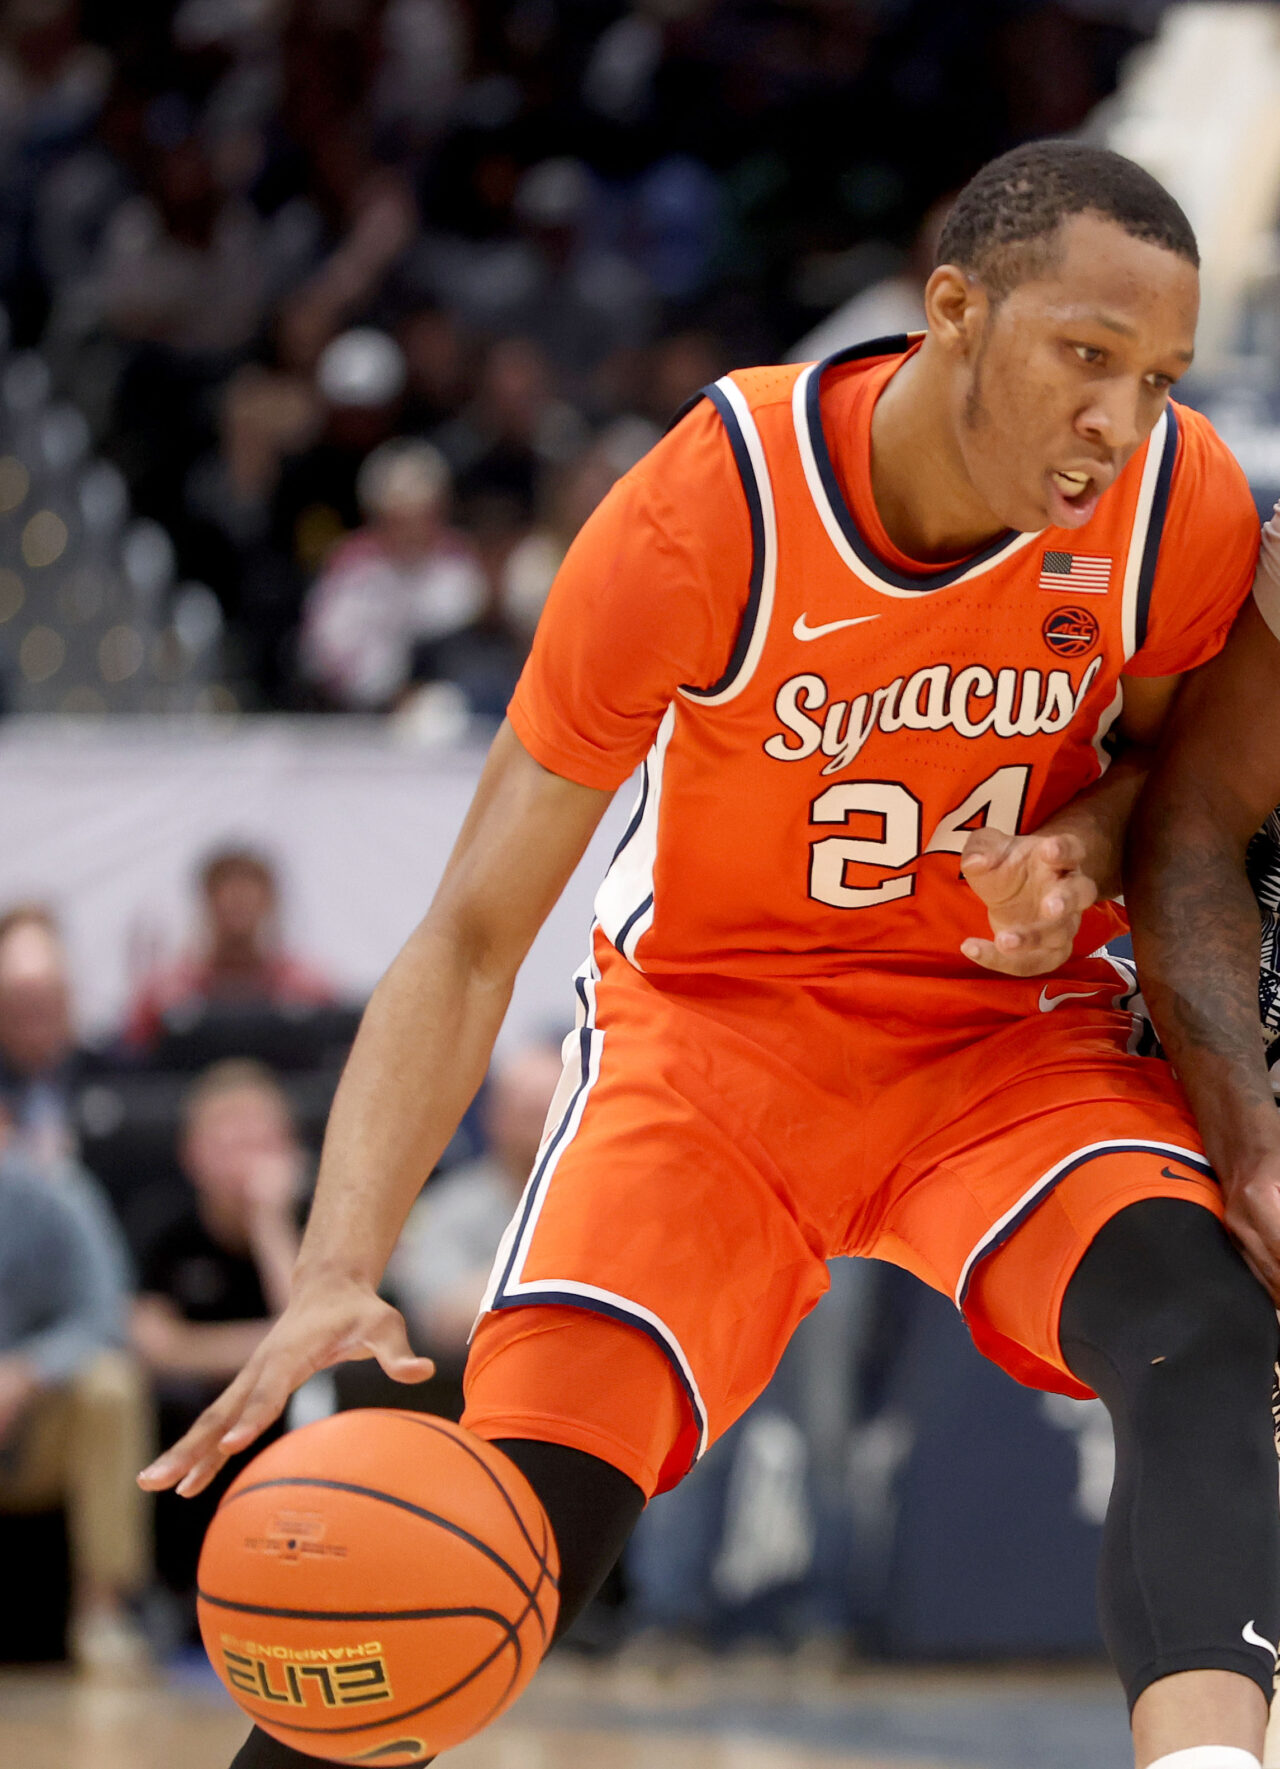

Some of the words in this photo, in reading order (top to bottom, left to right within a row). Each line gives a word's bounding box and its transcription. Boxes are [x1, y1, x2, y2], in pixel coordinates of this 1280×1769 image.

[1051, 622, 1096, 637] ACC
[808, 763, 1034, 910] 24
[221, 1648, 394, 1709] ELITE
